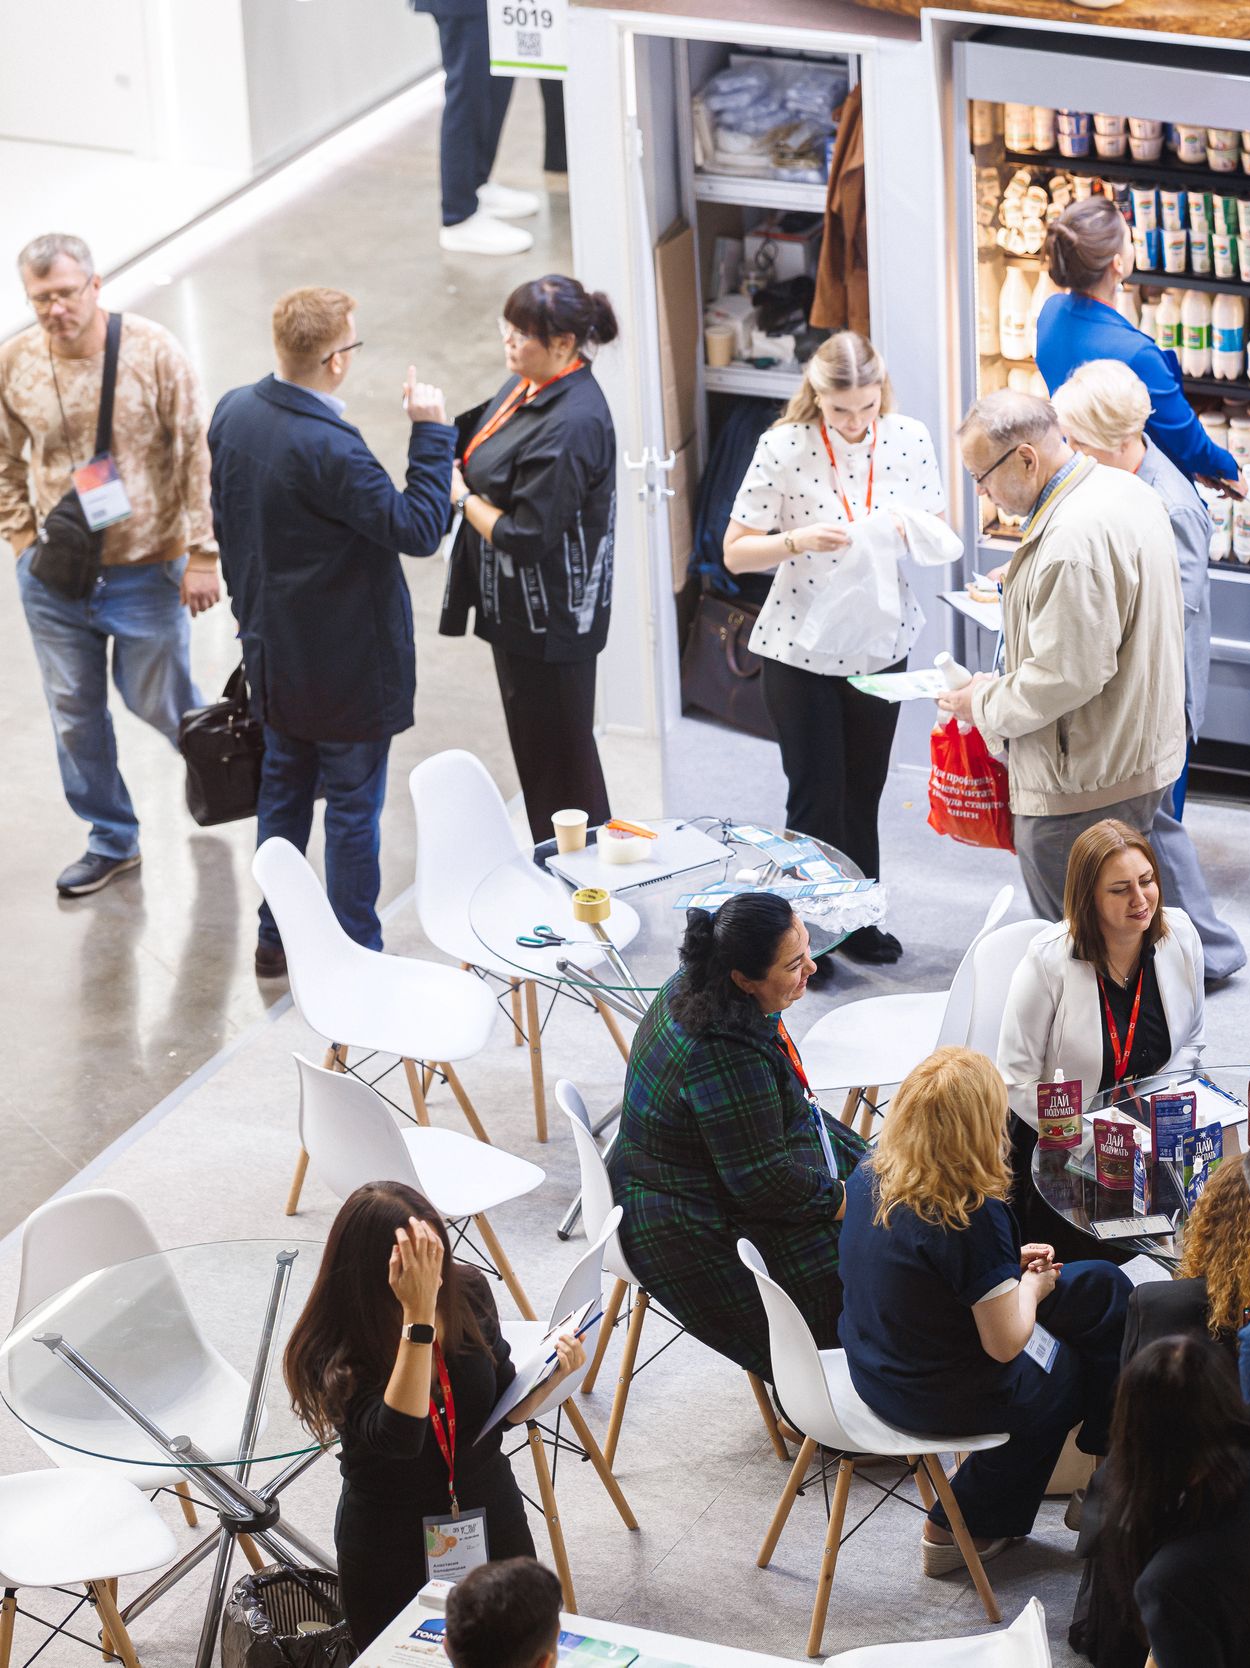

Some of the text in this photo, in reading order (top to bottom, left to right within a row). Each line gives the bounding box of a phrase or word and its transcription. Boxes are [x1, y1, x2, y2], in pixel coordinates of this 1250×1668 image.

[503, 6, 553, 28] 5019
[1049, 1093, 1070, 1109] ДАЙ
[1044, 1106, 1075, 1117] ПОДУМАТЬ
[1105, 1132, 1124, 1148] ДАЙ
[1195, 1136, 1214, 1156] ДАЙ
[1100, 1143, 1129, 1157] ПОДУМАТЬ
